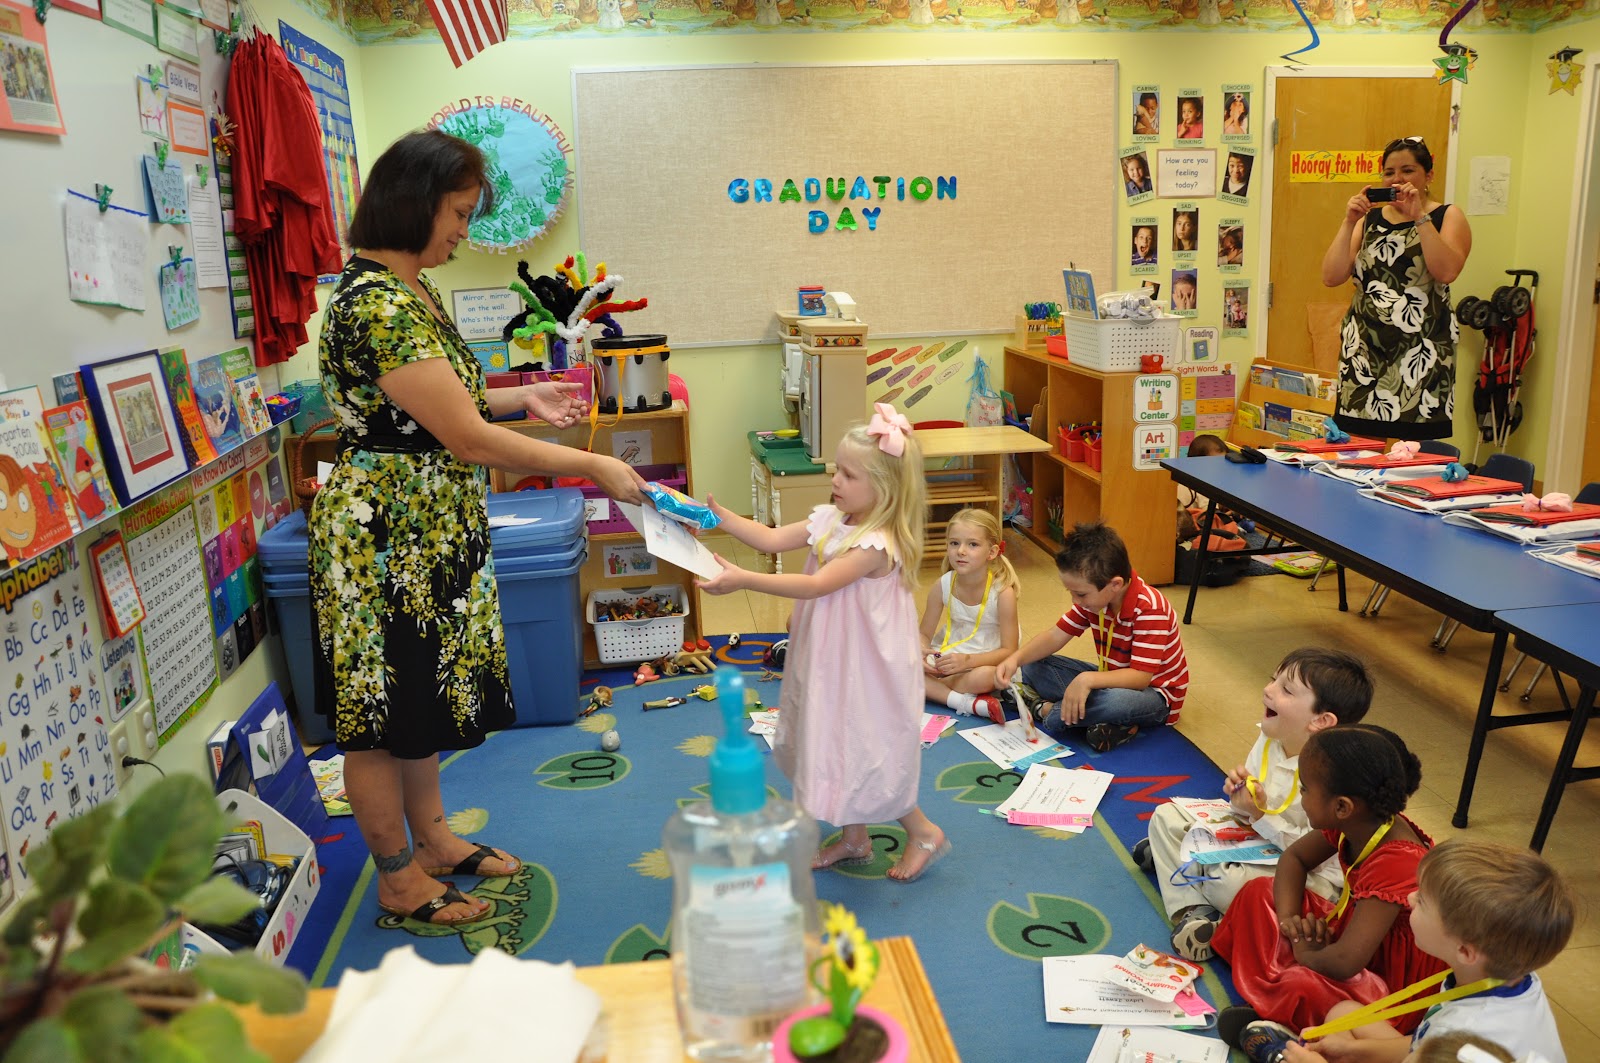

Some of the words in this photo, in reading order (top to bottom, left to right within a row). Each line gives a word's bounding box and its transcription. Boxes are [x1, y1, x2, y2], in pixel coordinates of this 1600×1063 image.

[170, 72, 183, 87] Bible
[184, 78, 199, 93] Verse
[423, 98, 471, 131] WORLD
[474, 95, 495, 109] IS
[500, 95, 574, 160] BEAUTIFUL
[1232, 146, 1255, 154] WORRIED
[1175, 169, 1199, 178] feeling
[1291, 152, 1331, 180] Hooray
[1335, 152, 1351, 174] for
[1355, 152, 1373, 174] the
[727, 175, 957, 204] GRADUATION
[1175, 181, 1199, 189] today?
[1132, 194, 1149, 203] HAPPY
[1221, 194, 1248, 204] DISGUSTED
[808, 206, 882, 234] DAY
[460, 316, 481, 324] Who's
[1190, 329, 1214, 339] Reading
[1177, 366, 1196, 375] Sight
[1197, 365, 1219, 373] Words
[1140, 379, 1171, 388] Writing
[1140, 411, 1170, 420] Center
[1144, 432, 1165, 444] Art
[192, 472, 203, 489] We
[202, 465, 219, 482] Know
[218, 459, 229, 475] Our
[227, 450, 243, 469] Colors
[123, 500, 170, 537] Hundreds
[168, 486, 191, 510] Chart
[4, 635, 24, 662] Bb
[30, 621, 49, 644] Cc
[52, 603, 69, 631] Dd
[72, 595, 86, 618] Ee
[101, 635, 136, 673] Listening
[8, 692, 31, 716] Gg
[33, 672, 52, 700] Hh
[55, 662, 65, 684] Ii
[68, 652, 77, 678] Jj
[80, 639, 94, 664] Kk
[0, 757, 13, 784] Ll
[18, 740, 43, 771] Mm
[46, 719, 66, 746] Nn
[69, 703, 87, 725] Oo
[88, 688, 101, 711] Pp
[568, 755, 617, 783] 10
[975, 770, 1025, 789] 3
[11, 804, 38, 831] Qq
[40, 781, 55, 805] Rr
[61, 763, 75, 785] Ss
[78, 746, 90, 768] Tt
[95, 730, 109, 752] Uu
[102, 773, 115, 796] Zz
[1021, 920, 1089, 949] 2
[1114, 964, 1144, 982] WORMS
[1144, 981, 1178, 991] GUMMY
